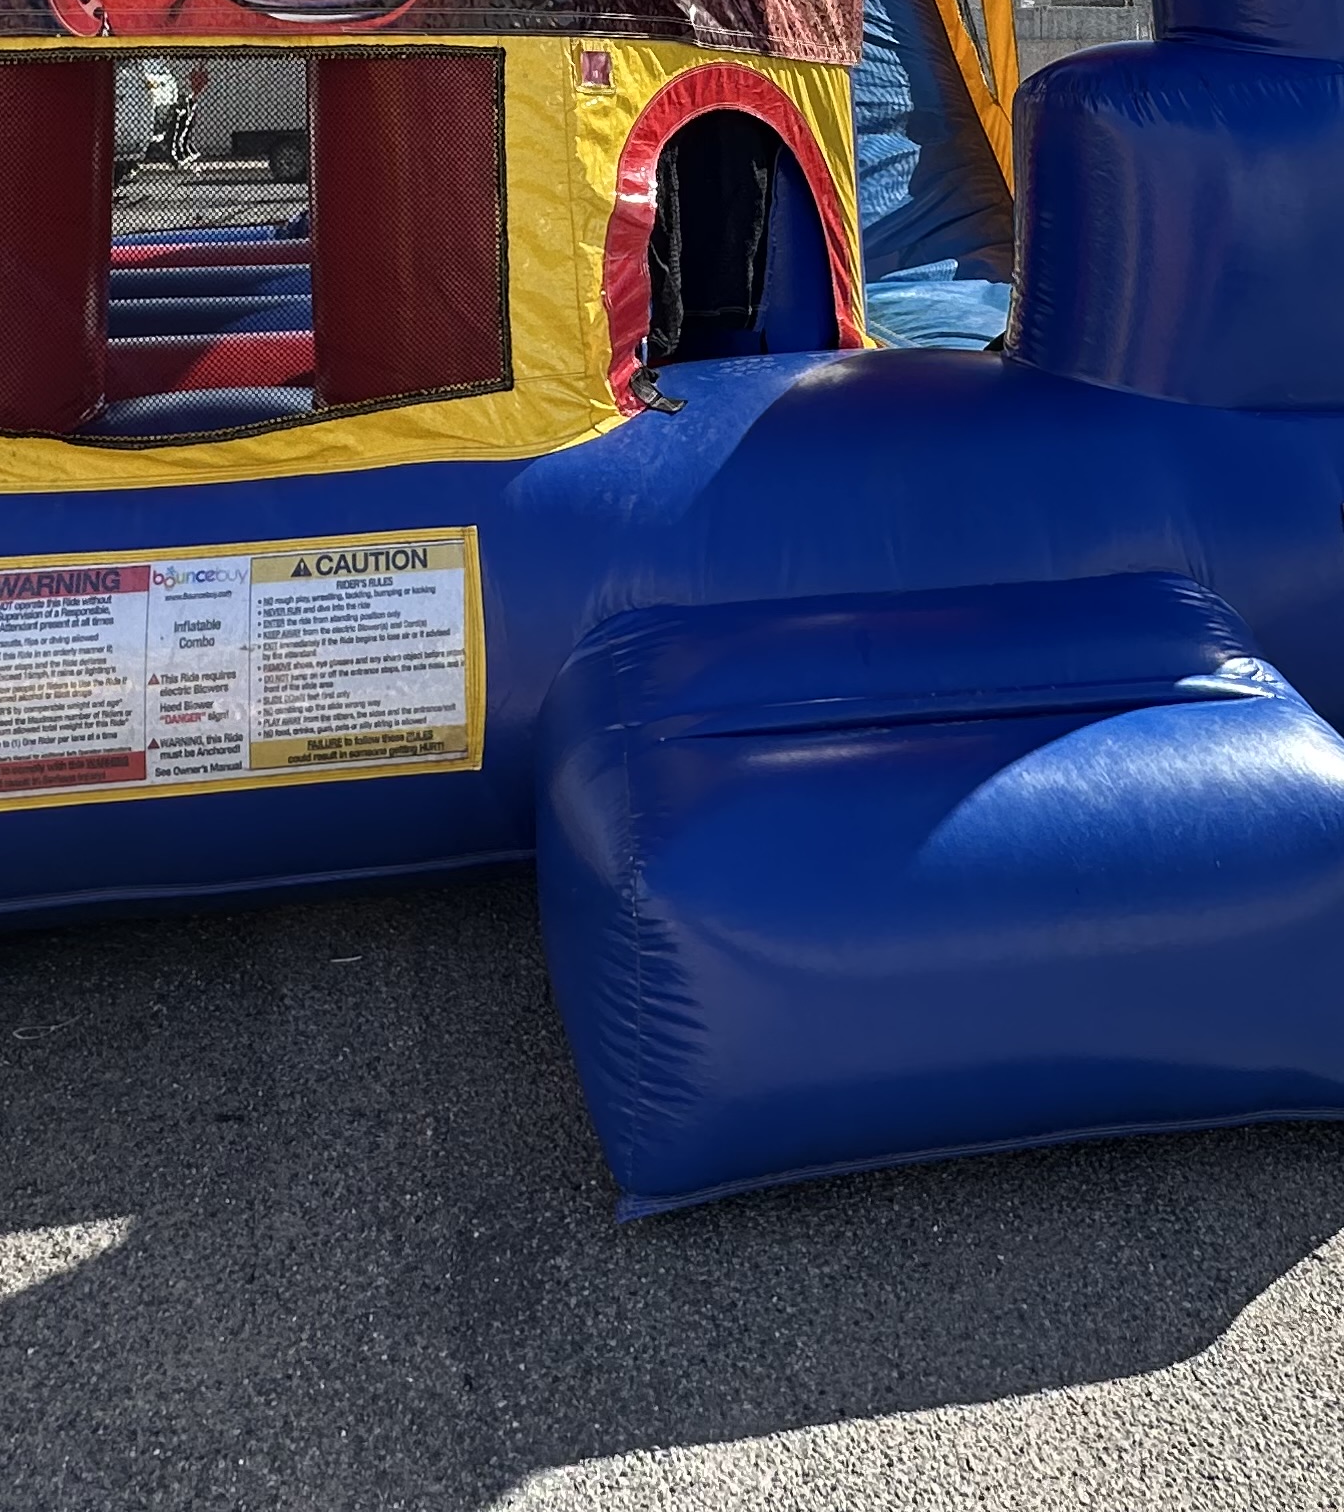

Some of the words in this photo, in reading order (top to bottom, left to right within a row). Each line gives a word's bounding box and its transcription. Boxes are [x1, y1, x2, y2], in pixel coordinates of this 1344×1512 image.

[315, 549, 427, 574] CAUTION
[152, 567, 247, 588] bouncebuy
[174, 618, 220, 632] Inflatable
[179, 635, 214, 648] Combo
[160, 673, 178, 684] This
[180, 672, 198, 682] Ride
[201, 669, 236, 681] requires
[206, 733, 221, 744] this
[224, 731, 243, 742] Ride
[159, 749, 182, 759] must
[185, 748, 195, 757] be
[155, 767, 170, 776] See
[210, 760, 242, 771] Manual
